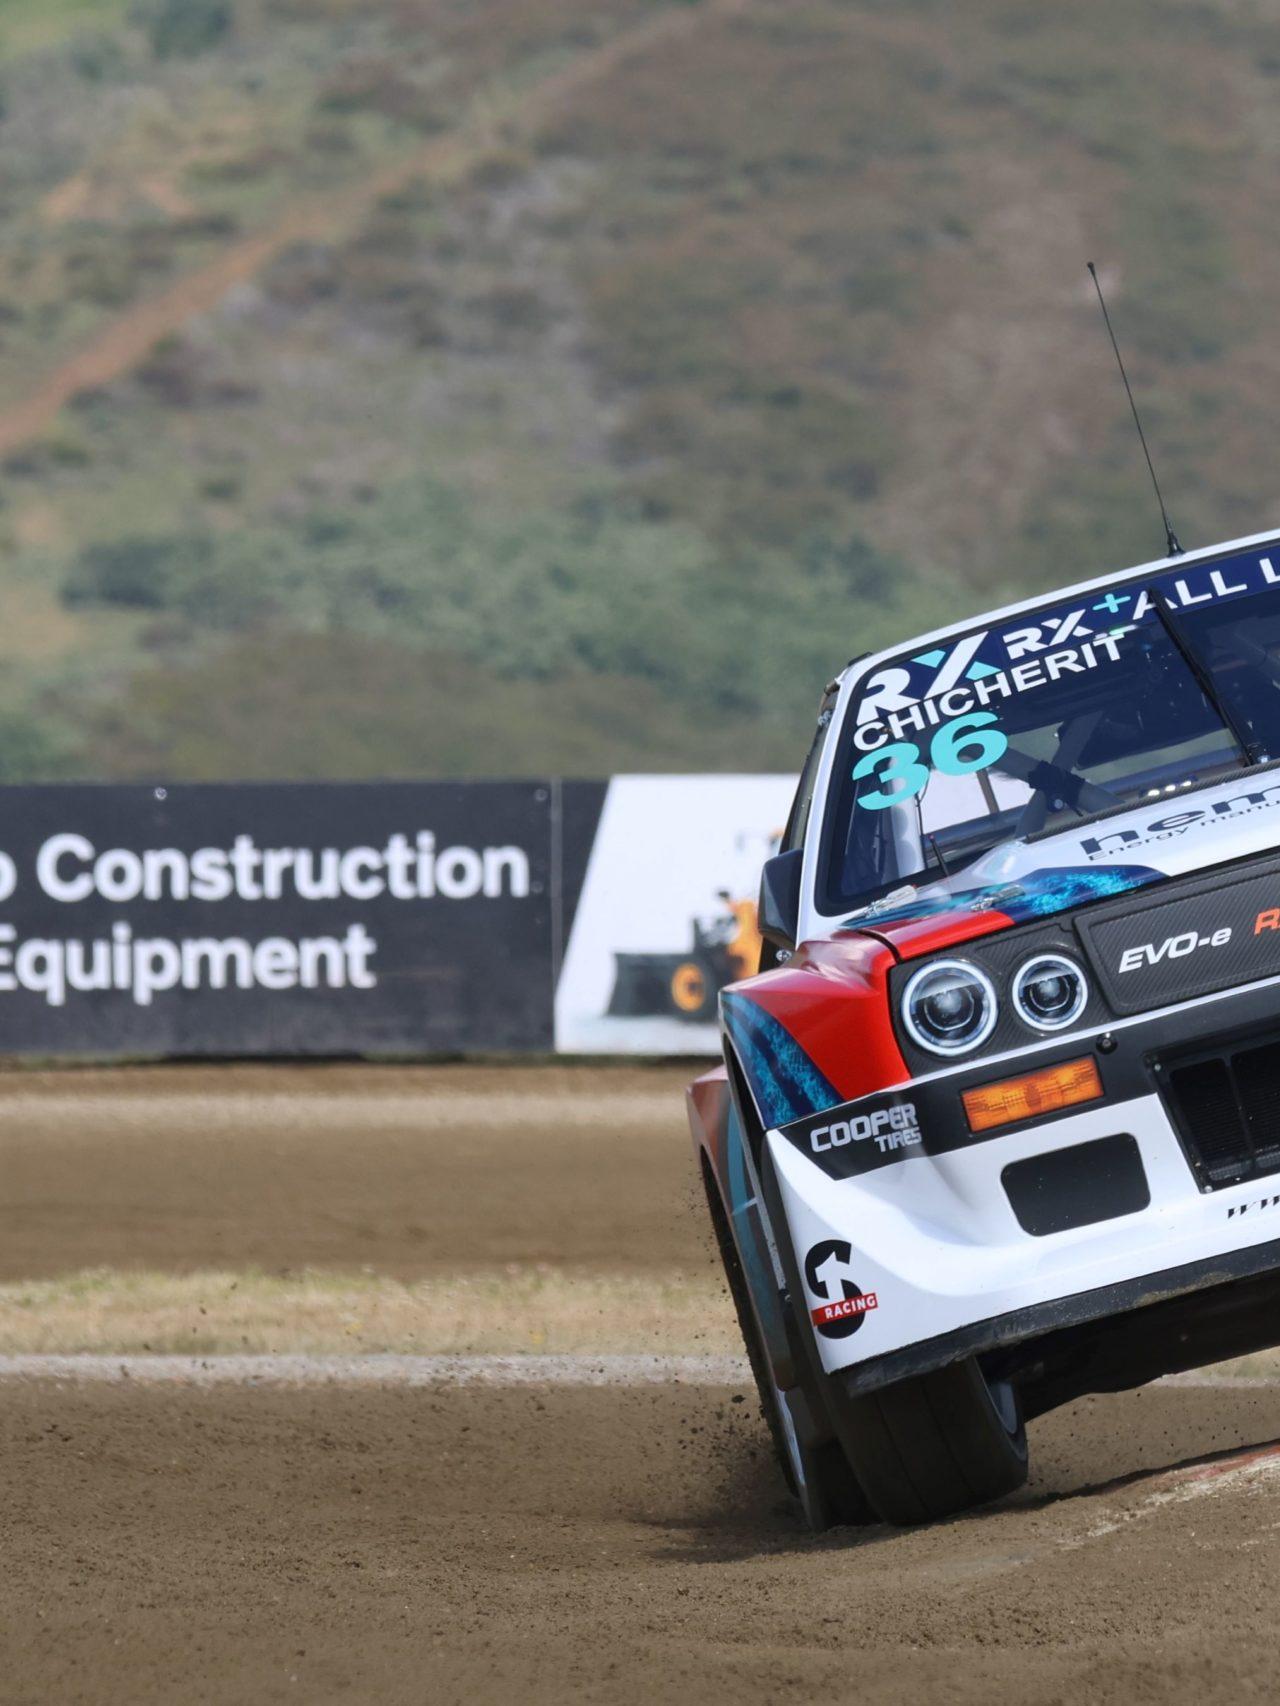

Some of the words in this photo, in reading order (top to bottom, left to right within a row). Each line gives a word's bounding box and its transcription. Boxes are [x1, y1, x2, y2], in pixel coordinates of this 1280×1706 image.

[856, 631, 1001, 726] RX
[1132, 570, 1247, 620] ALL
[853, 632, 1125, 751] CHICHERIT
[852, 711, 1008, 811] 36
[37, 830, 529, 902] Construction
[0, 921, 377, 1006] Equipment
[1118, 927, 1232, 973] EVO-e
[810, 1103, 918, 1152] COOPER
[874, 1126, 922, 1152] TIRES
[825, 1296, 876, 1319] RACING
